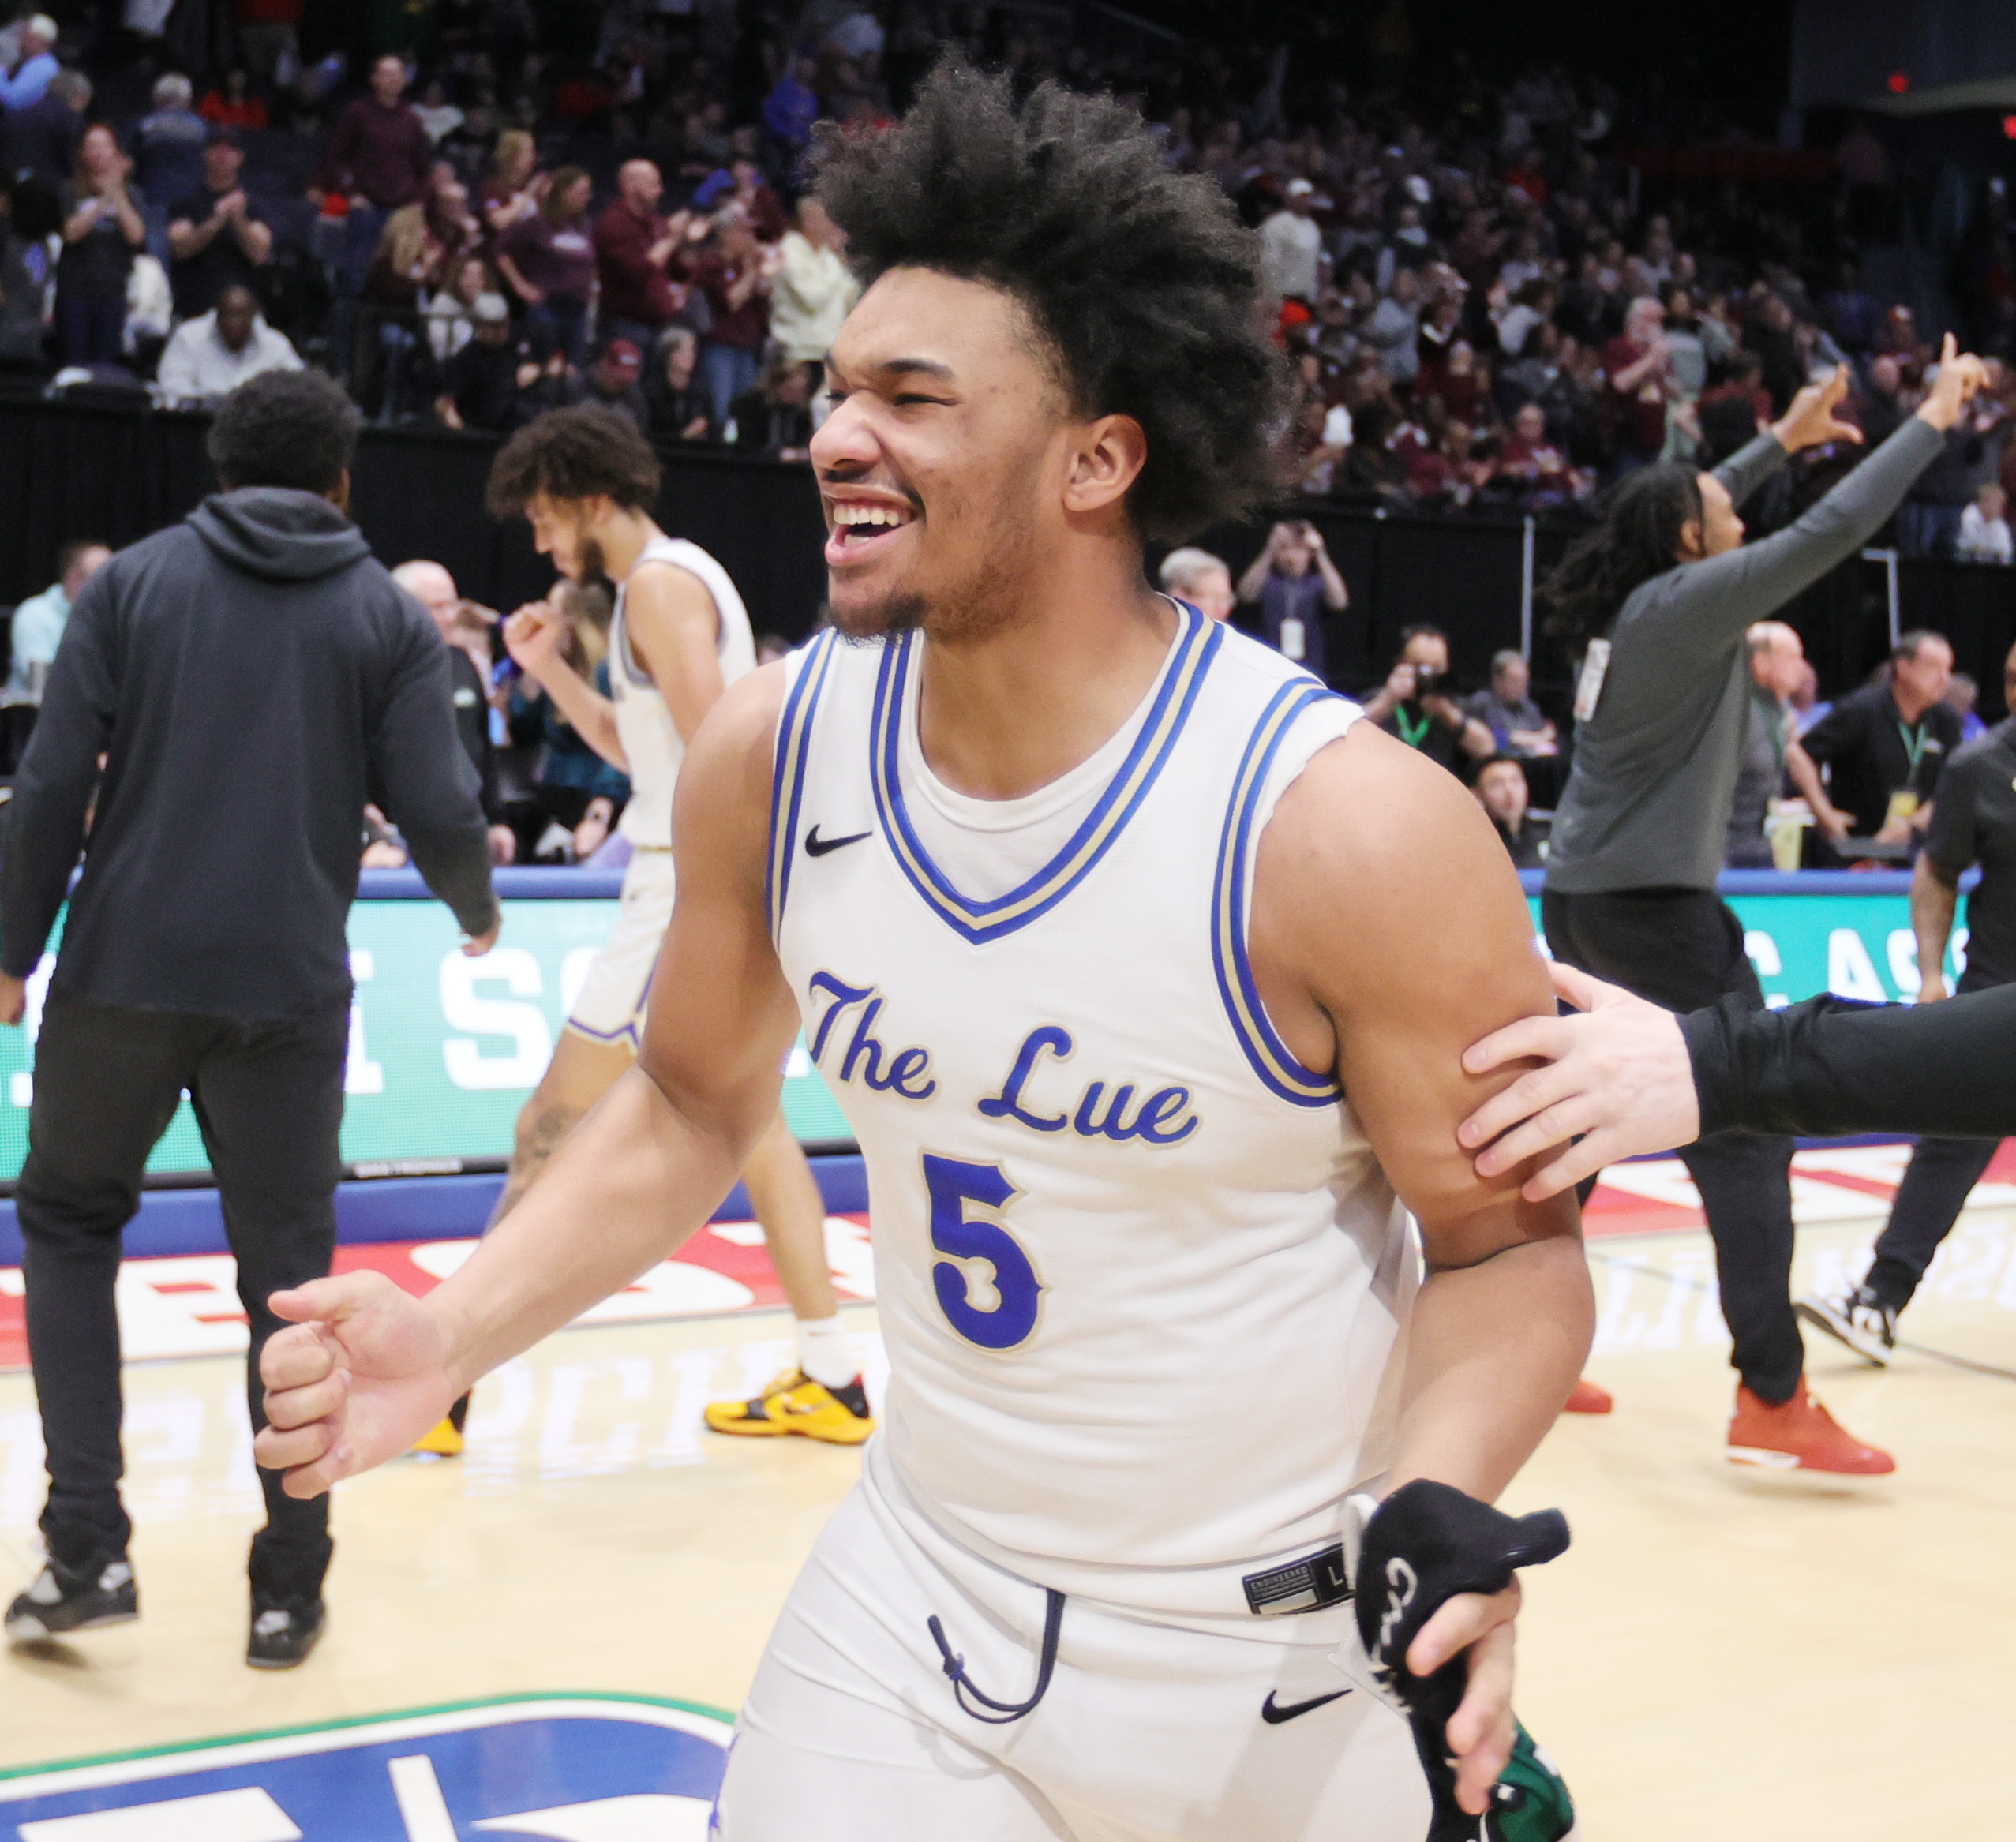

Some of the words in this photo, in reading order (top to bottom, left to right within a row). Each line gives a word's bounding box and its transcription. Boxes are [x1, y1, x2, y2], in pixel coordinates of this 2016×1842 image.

[807, 968, 939, 1103] The
[976, 1024, 1201, 1148] Lue
[920, 1148, 1051, 1353] 5
